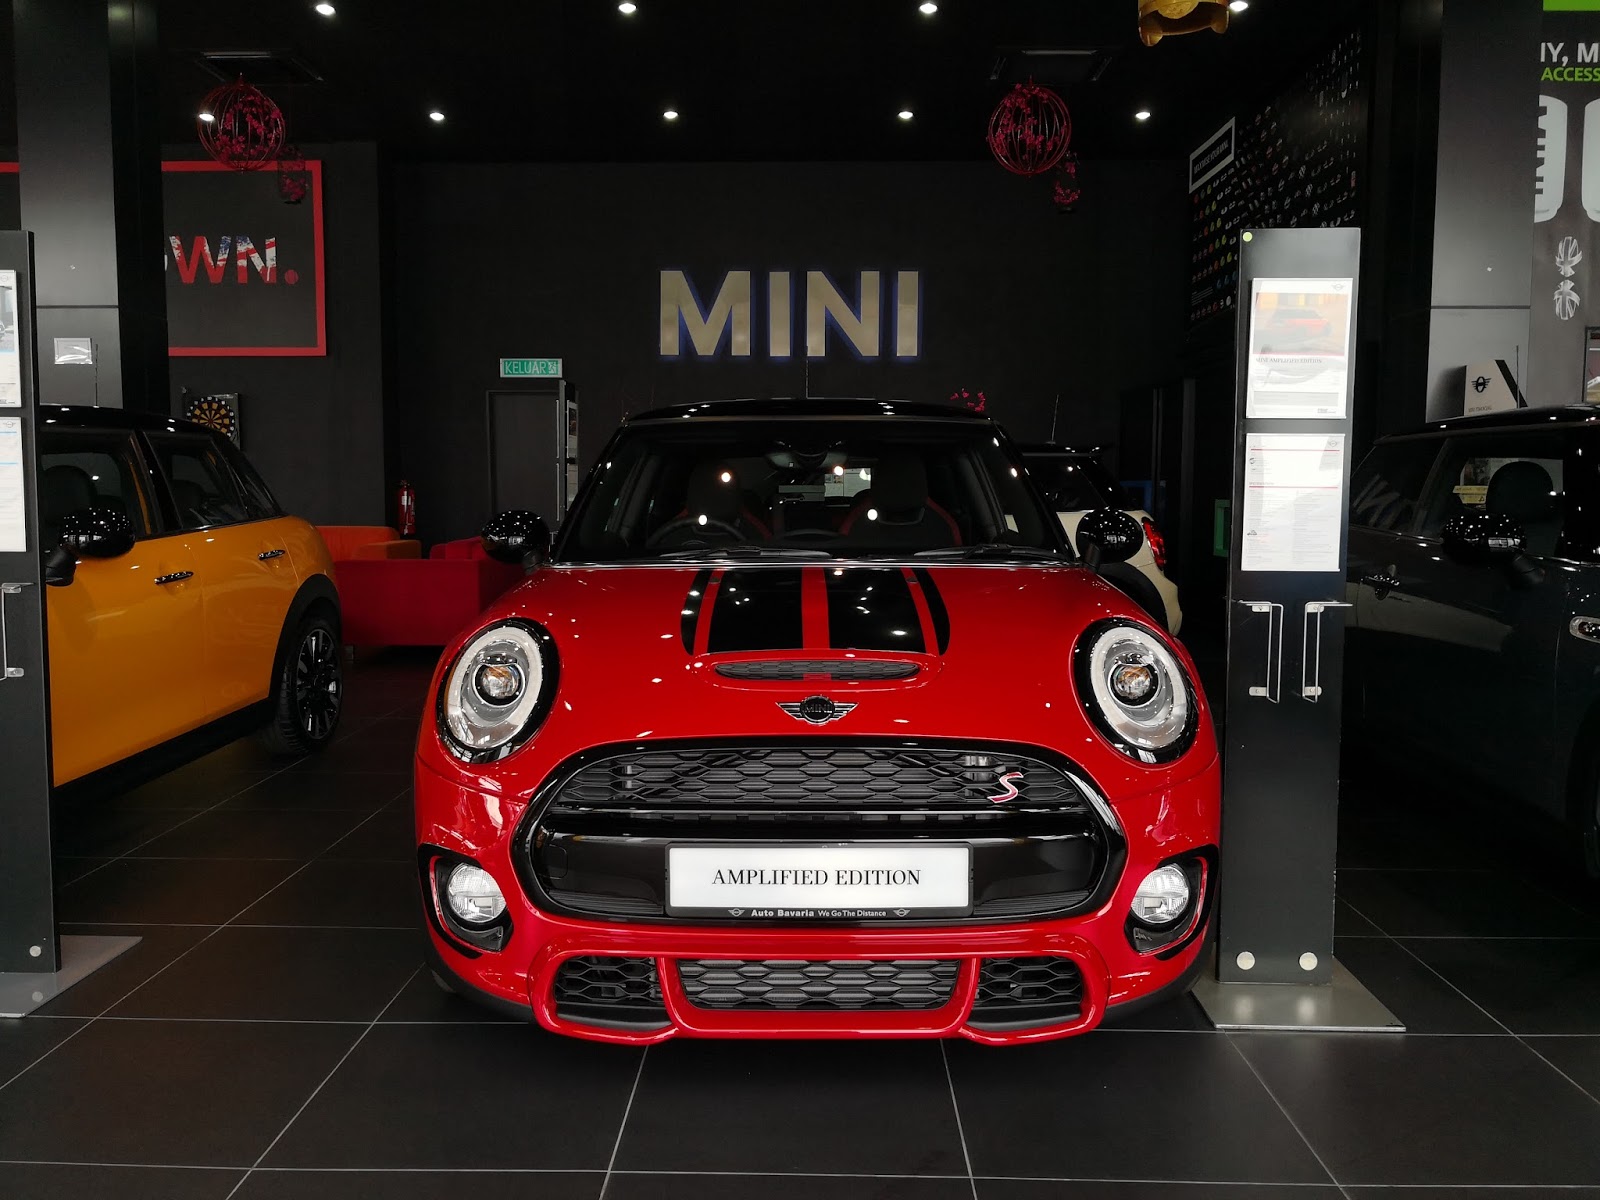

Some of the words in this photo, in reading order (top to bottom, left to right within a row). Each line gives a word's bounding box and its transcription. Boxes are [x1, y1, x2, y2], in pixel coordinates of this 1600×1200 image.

[164, 235, 299, 285] WN.
[660, 270, 919, 357] MINI
[505, 361, 547, 374] KELUAR
[803, 703, 833, 713] MINI
[987, 772, 1024, 803] S
[712, 869, 828, 885] AMPLIFIED
[835, 869, 921, 885] EDITION
[751, 909, 774, 917] Auto
[777, 909, 815, 917] Bavaria
[818, 909, 830, 917] We
[831, 909, 842, 917] Go
